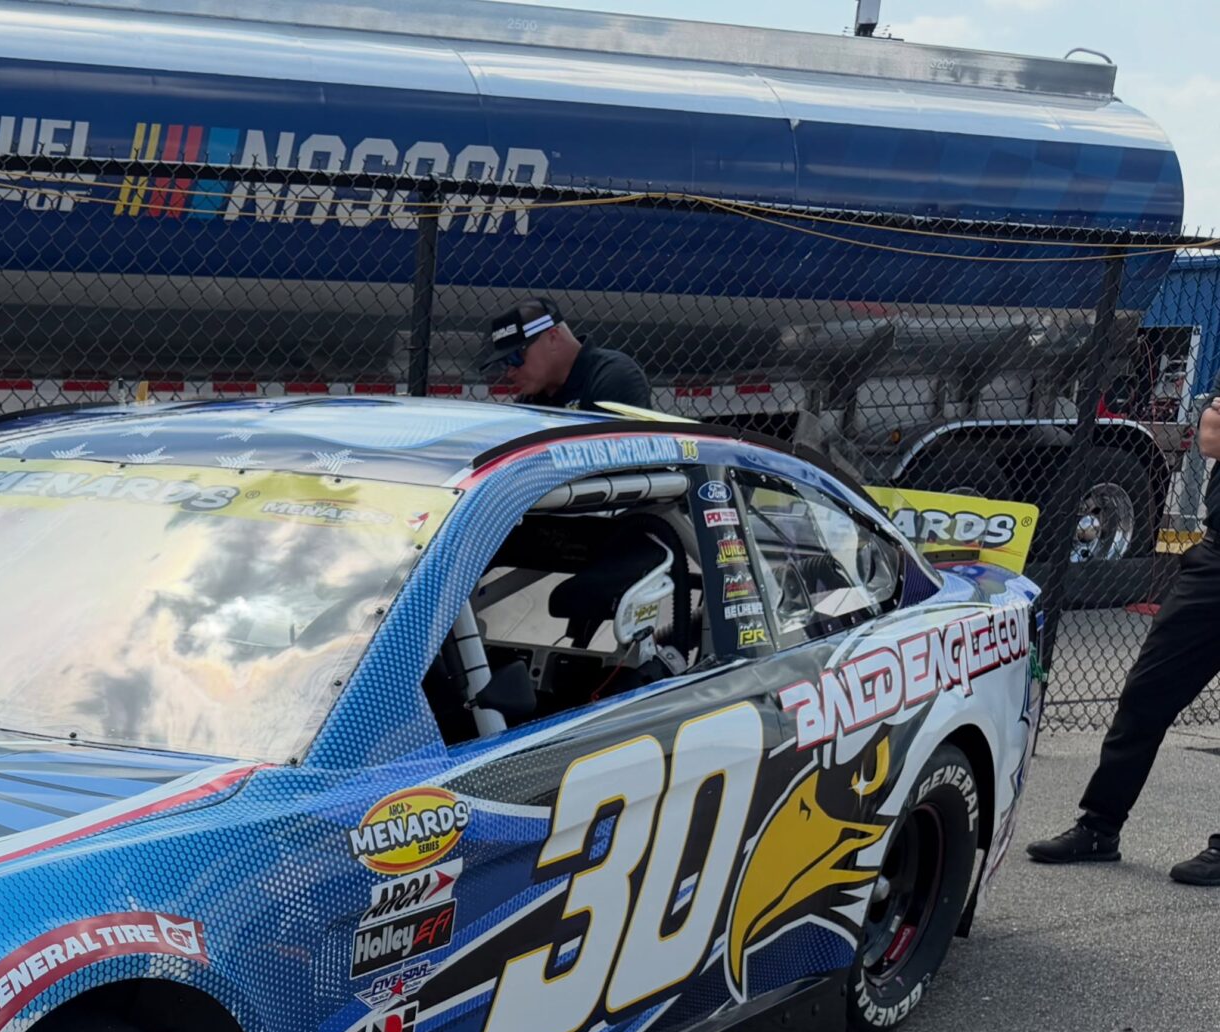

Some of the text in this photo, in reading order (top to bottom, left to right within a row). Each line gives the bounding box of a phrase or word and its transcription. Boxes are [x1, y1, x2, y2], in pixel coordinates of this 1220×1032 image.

[223, 128, 550, 237] NASCAR
[707, 483, 728, 499] Ford
[261, 501, 393, 525] MENARDS
[881, 508, 1016, 549] ARDS
[916, 764, 981, 833] GENERAL
[349, 801, 469, 858] MENARDS
[418, 840, 440, 855] SERIES
[96, 924, 160, 947] TIRE
[354, 922, 415, 965] Holley
[371, 963, 429, 996] FIVE STAR
[854, 966, 924, 1029] GENERAL
